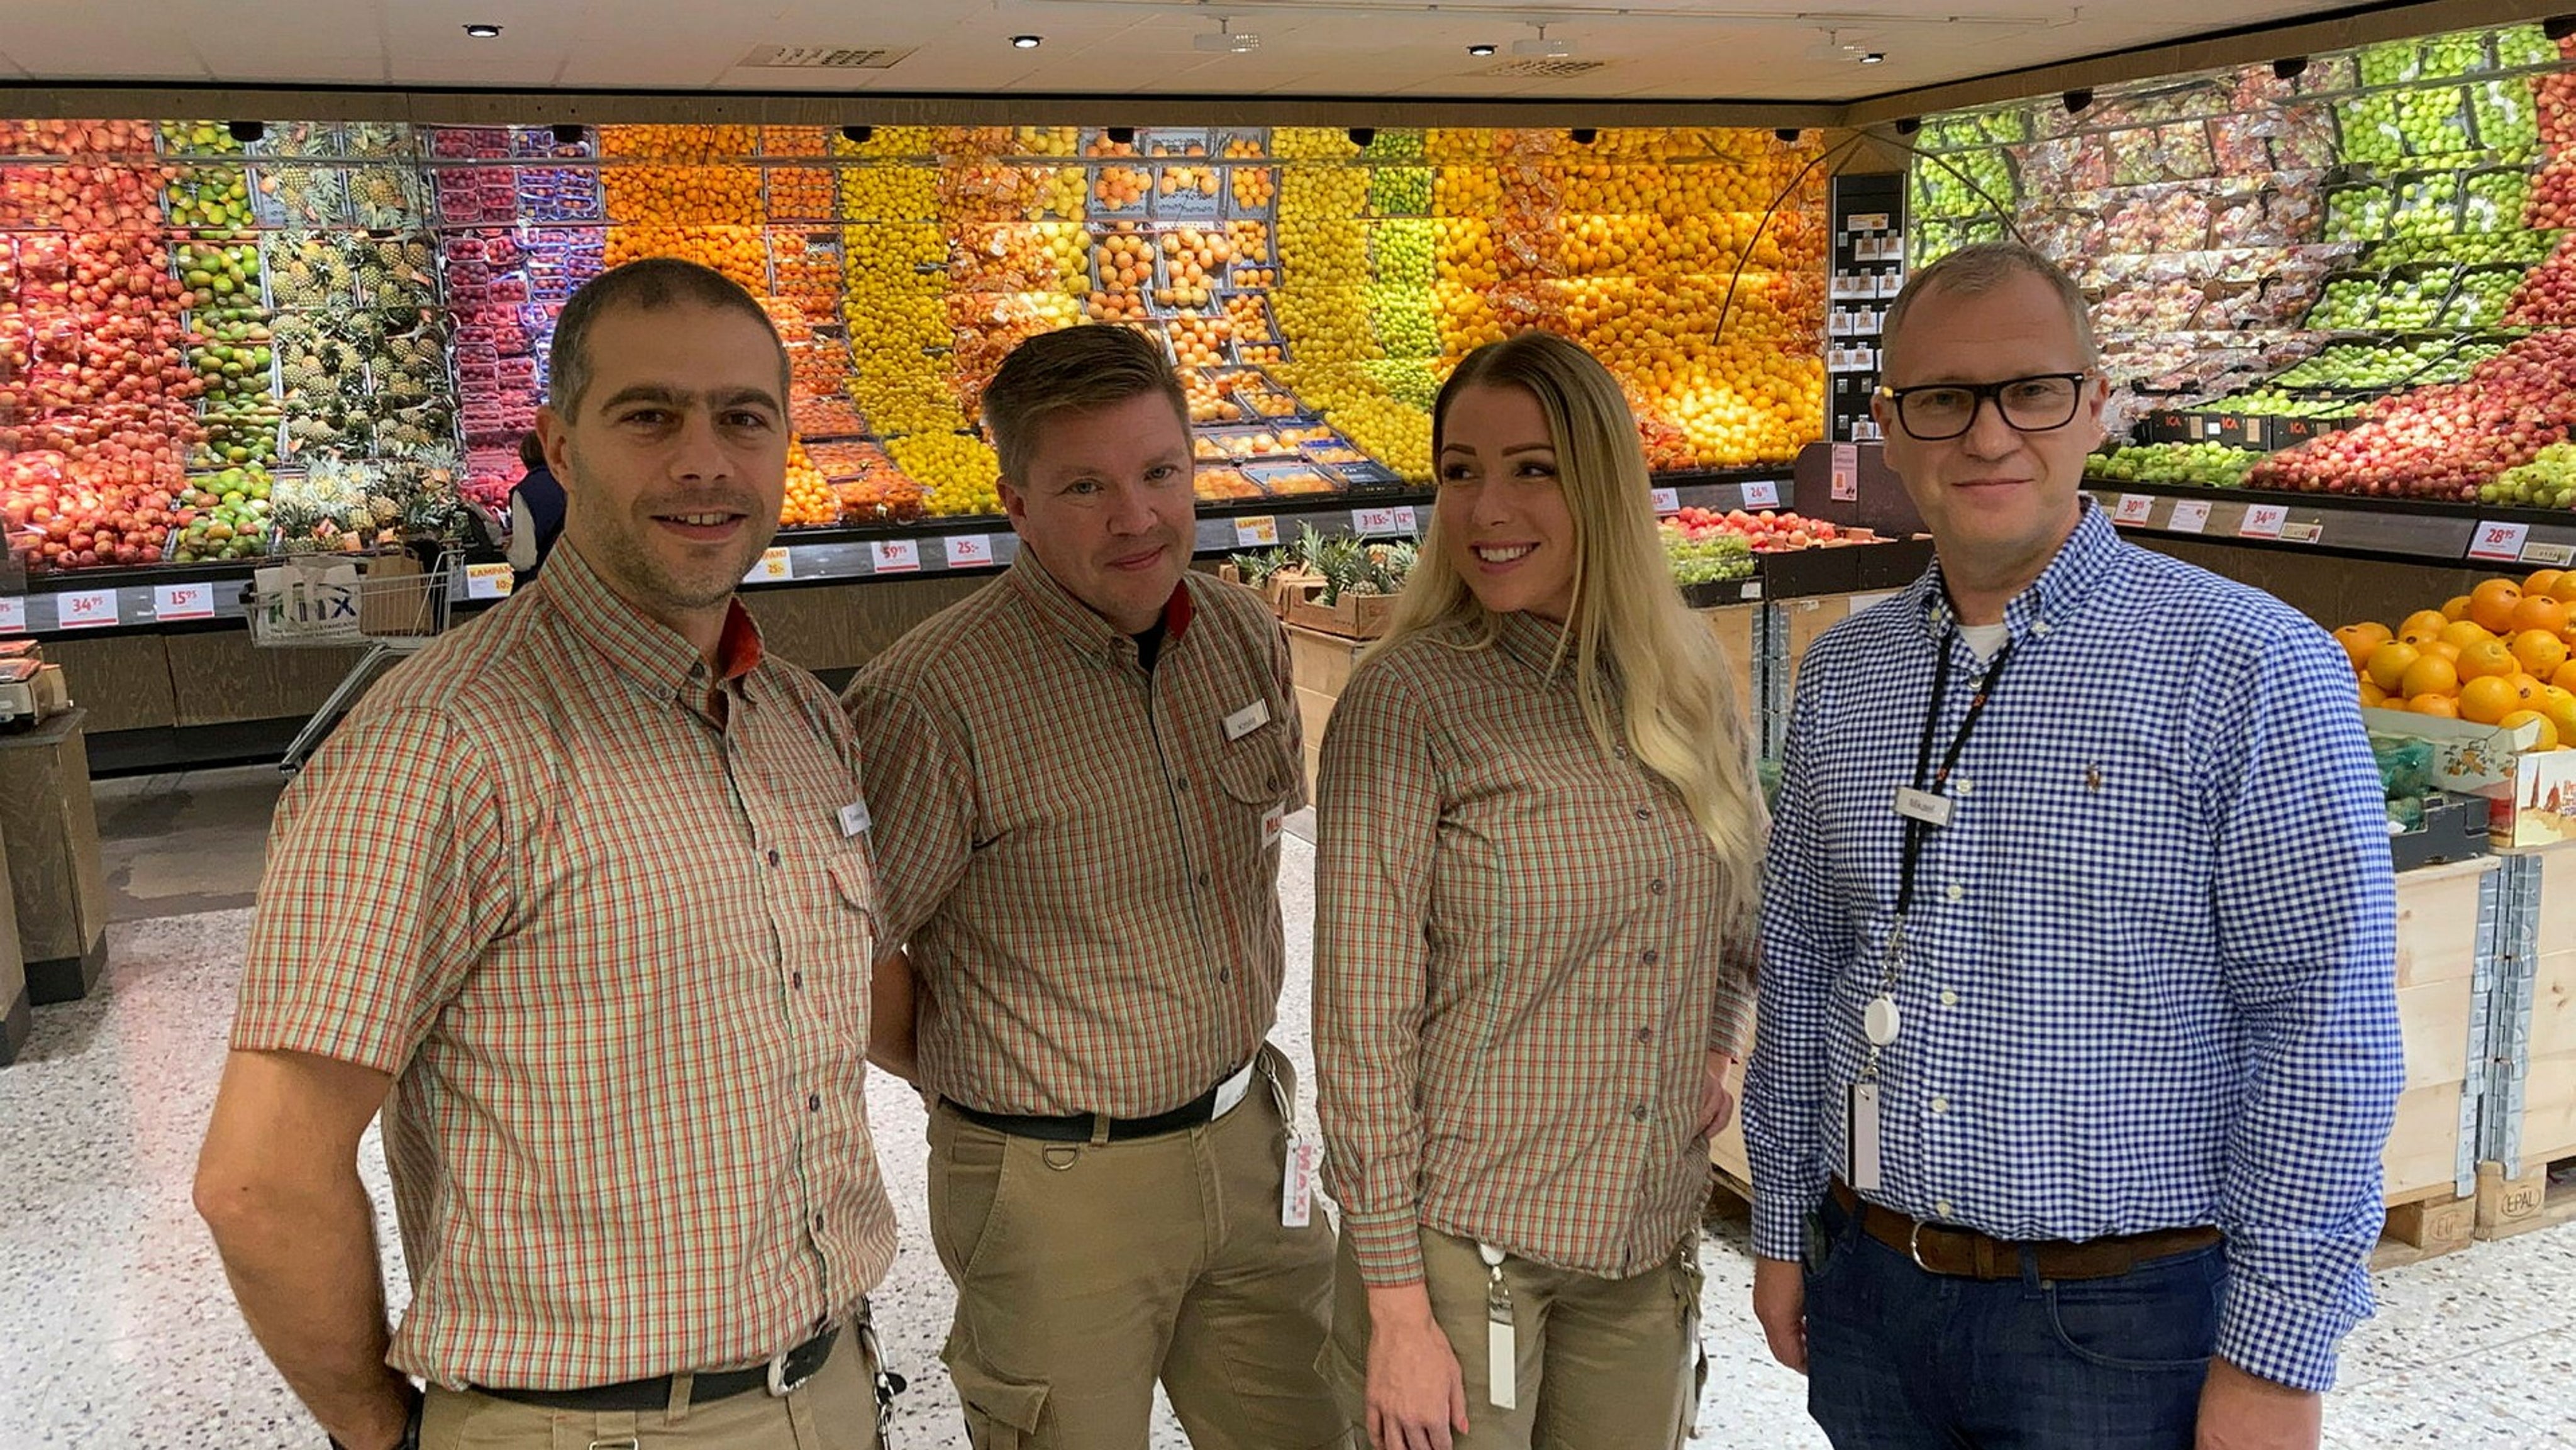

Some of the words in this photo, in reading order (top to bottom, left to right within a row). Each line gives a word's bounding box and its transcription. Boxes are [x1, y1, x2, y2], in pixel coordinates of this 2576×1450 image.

[2165, 416, 2182, 427] ICA
[2221, 417, 2239, 429] ICA
[2290, 422, 2307, 434] ICA
[470, 565, 512, 577] KAMPAN
[2507, 1190, 2535, 1213] EPAL
